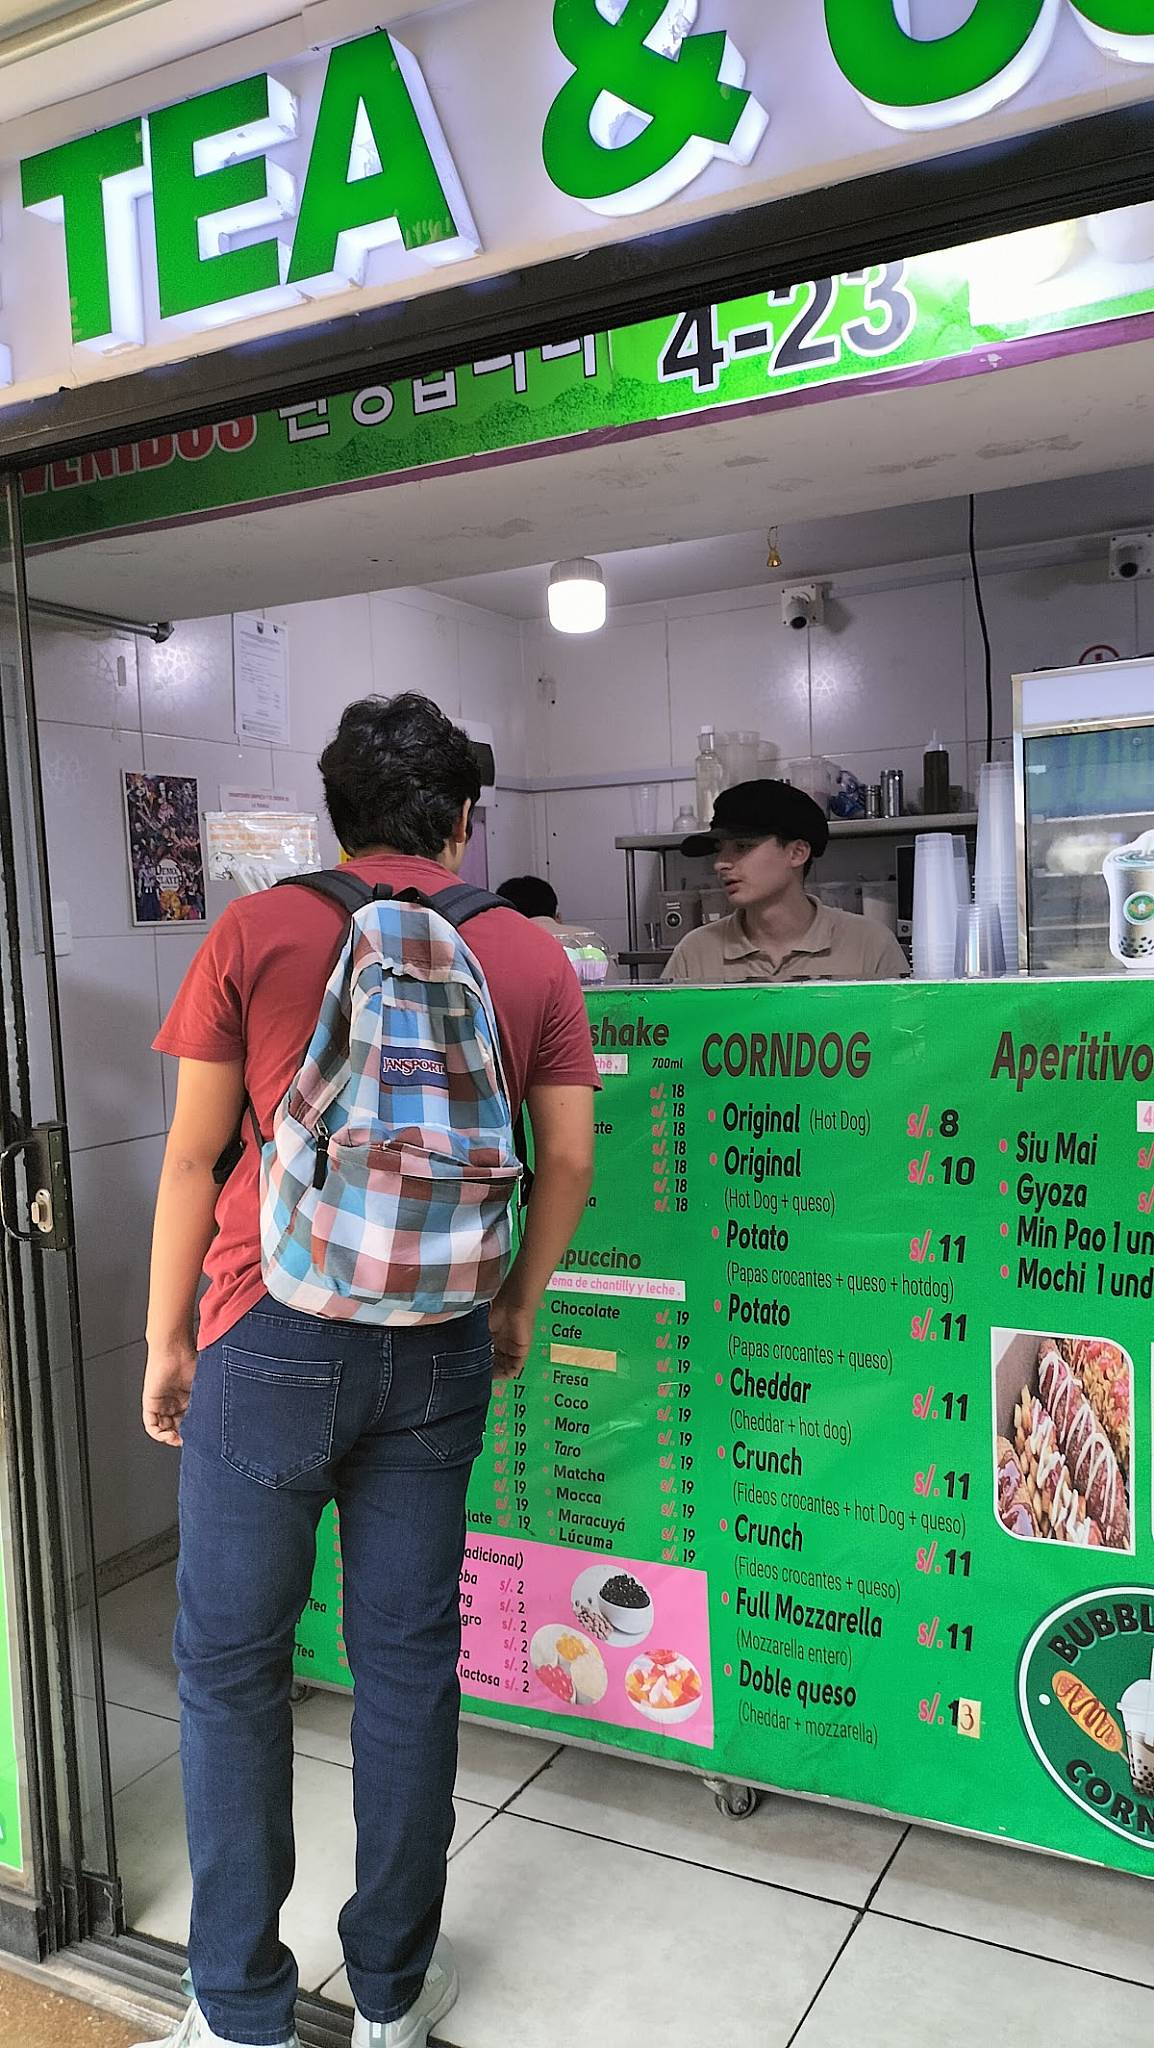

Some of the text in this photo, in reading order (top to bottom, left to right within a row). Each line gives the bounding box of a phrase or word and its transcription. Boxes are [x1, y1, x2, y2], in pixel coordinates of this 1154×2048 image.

[20, 28, 460, 345] TEA
[652, 1057, 684, 1069] 700ml
[702, 1032, 871, 1078] CORNDOG
[990, 1031, 1154, 1092] Aperitivo
[672, 1084, 685, 1098] 18
[673, 1103, 685, 1117] 18
[723, 1102, 800, 1140] Original
[809, 1109, 837, 1136] (Hot
[840, 1112, 871, 1137] Dog)
[939, 1109, 959, 1138] 8
[673, 1122, 686, 1136] 18
[674, 1141, 686, 1155] 18
[1016, 1130, 1098, 1165] Siu Mai
[675, 1160, 687, 1174] 18
[724, 1146, 801, 1184] Original
[940, 1156, 976, 1185] 10
[675, 1179, 687, 1193] 18
[1016, 1173, 1087, 1213] Gyoza
[676, 1198, 688, 1212] 18
[724, 1187, 751, 1213] (Hot
[754, 1191, 778, 1215] Dog
[792, 1191, 835, 1217] queso)
[727, 1220, 789, 1251] Potato
[939, 1234, 966, 1263] 11
[1017, 1215, 1057, 1248] Min
[1064, 1219, 1106, 1251] Pao
[575, 1277, 588, 1288] de
[590, 1279, 635, 1295] chantilly
[637, 1283, 645, 1294] y
[727, 1260, 768, 1286] (Papas
[771, 1265, 832, 1288] crocantes
[847, 1274, 887, 1296] queso
[902, 1274, 954, 1304] hotdog)
[1017, 1257, 1086, 1293] Mochi
[550, 1300, 690, 1325] Chocolate 19
[728, 1294, 790, 1327] Potato
[940, 1312, 967, 1342] 11
[551, 1323, 690, 1349] Cafe 19
[678, 1359, 691, 1374] 19
[728, 1333, 770, 1359] (Papas
[773, 1340, 834, 1365] crocantes
[849, 1350, 893, 1376] queso)
[513, 1384, 525, 1399] 17
[553, 1370, 691, 1398] Fresa 19
[730, 1367, 812, 1404] Cheddar
[941, 1392, 969, 1421] 11
[514, 1404, 526, 1418] 19
[554, 1393, 691, 1422] Coco 19
[514, 1423, 526, 1437] 19
[554, 1416, 692, 1446] Mora 19
[730, 1408, 784, 1434] (Cheddar
[799, 1417, 820, 1437] hot
[823, 1421, 852, 1447] dog)
[514, 1442, 526, 1456] 19
[554, 1440, 693, 1470] Taro 19
[514, 1461, 525, 1475] 19
[554, 1464, 694, 1494] Matcha 19
[732, 1441, 803, 1476] Crunch
[944, 1471, 971, 1500] 11
[514, 1480, 526, 1494] 19
[516, 1498, 528, 1511] 19
[556, 1487, 694, 1518] Mocca 19
[733, 1480, 777, 1507] (Fideos
[780, 1489, 840, 1517] crocantes
[855, 1502, 875, 1522] hot
[879, 1504, 906, 1531] Dog
[920, 1512, 966, 1540] queso)
[518, 1515, 530, 1530] 19
[558, 1507, 695, 1543] Maracuyá 19
[559, 1527, 695, 1563] Lúcuma 19
[734, 1514, 804, 1552] Crunch
[945, 1548, 972, 1577] 11
[517, 1580, 524, 1594] 2
[734, 1553, 778, 1579] (Fideos
[782, 1562, 842, 1592] crocantes
[857, 1579, 901, 1604] queso)
[518, 1601, 525, 1614] 2
[736, 1586, 770, 1619] Full
[775, 1593, 882, 1638] Mozzarella
[946, 1623, 973, 1652] 11
[520, 1620, 527, 1633] 2
[521, 1640, 528, 1653] 2
[736, 1628, 853, 1672] (Mozzarella entero)
[460, 1665, 500, 1686] lactosa
[522, 1680, 529, 1693] 2
[522, 1660, 528, 1673] 2
[739, 1660, 792, 1698] Doble
[797, 1681, 857, 1709] queso
[738, 1699, 791, 1731] (Cheddar
[805, 1719, 878, 1748] mozzarella)
